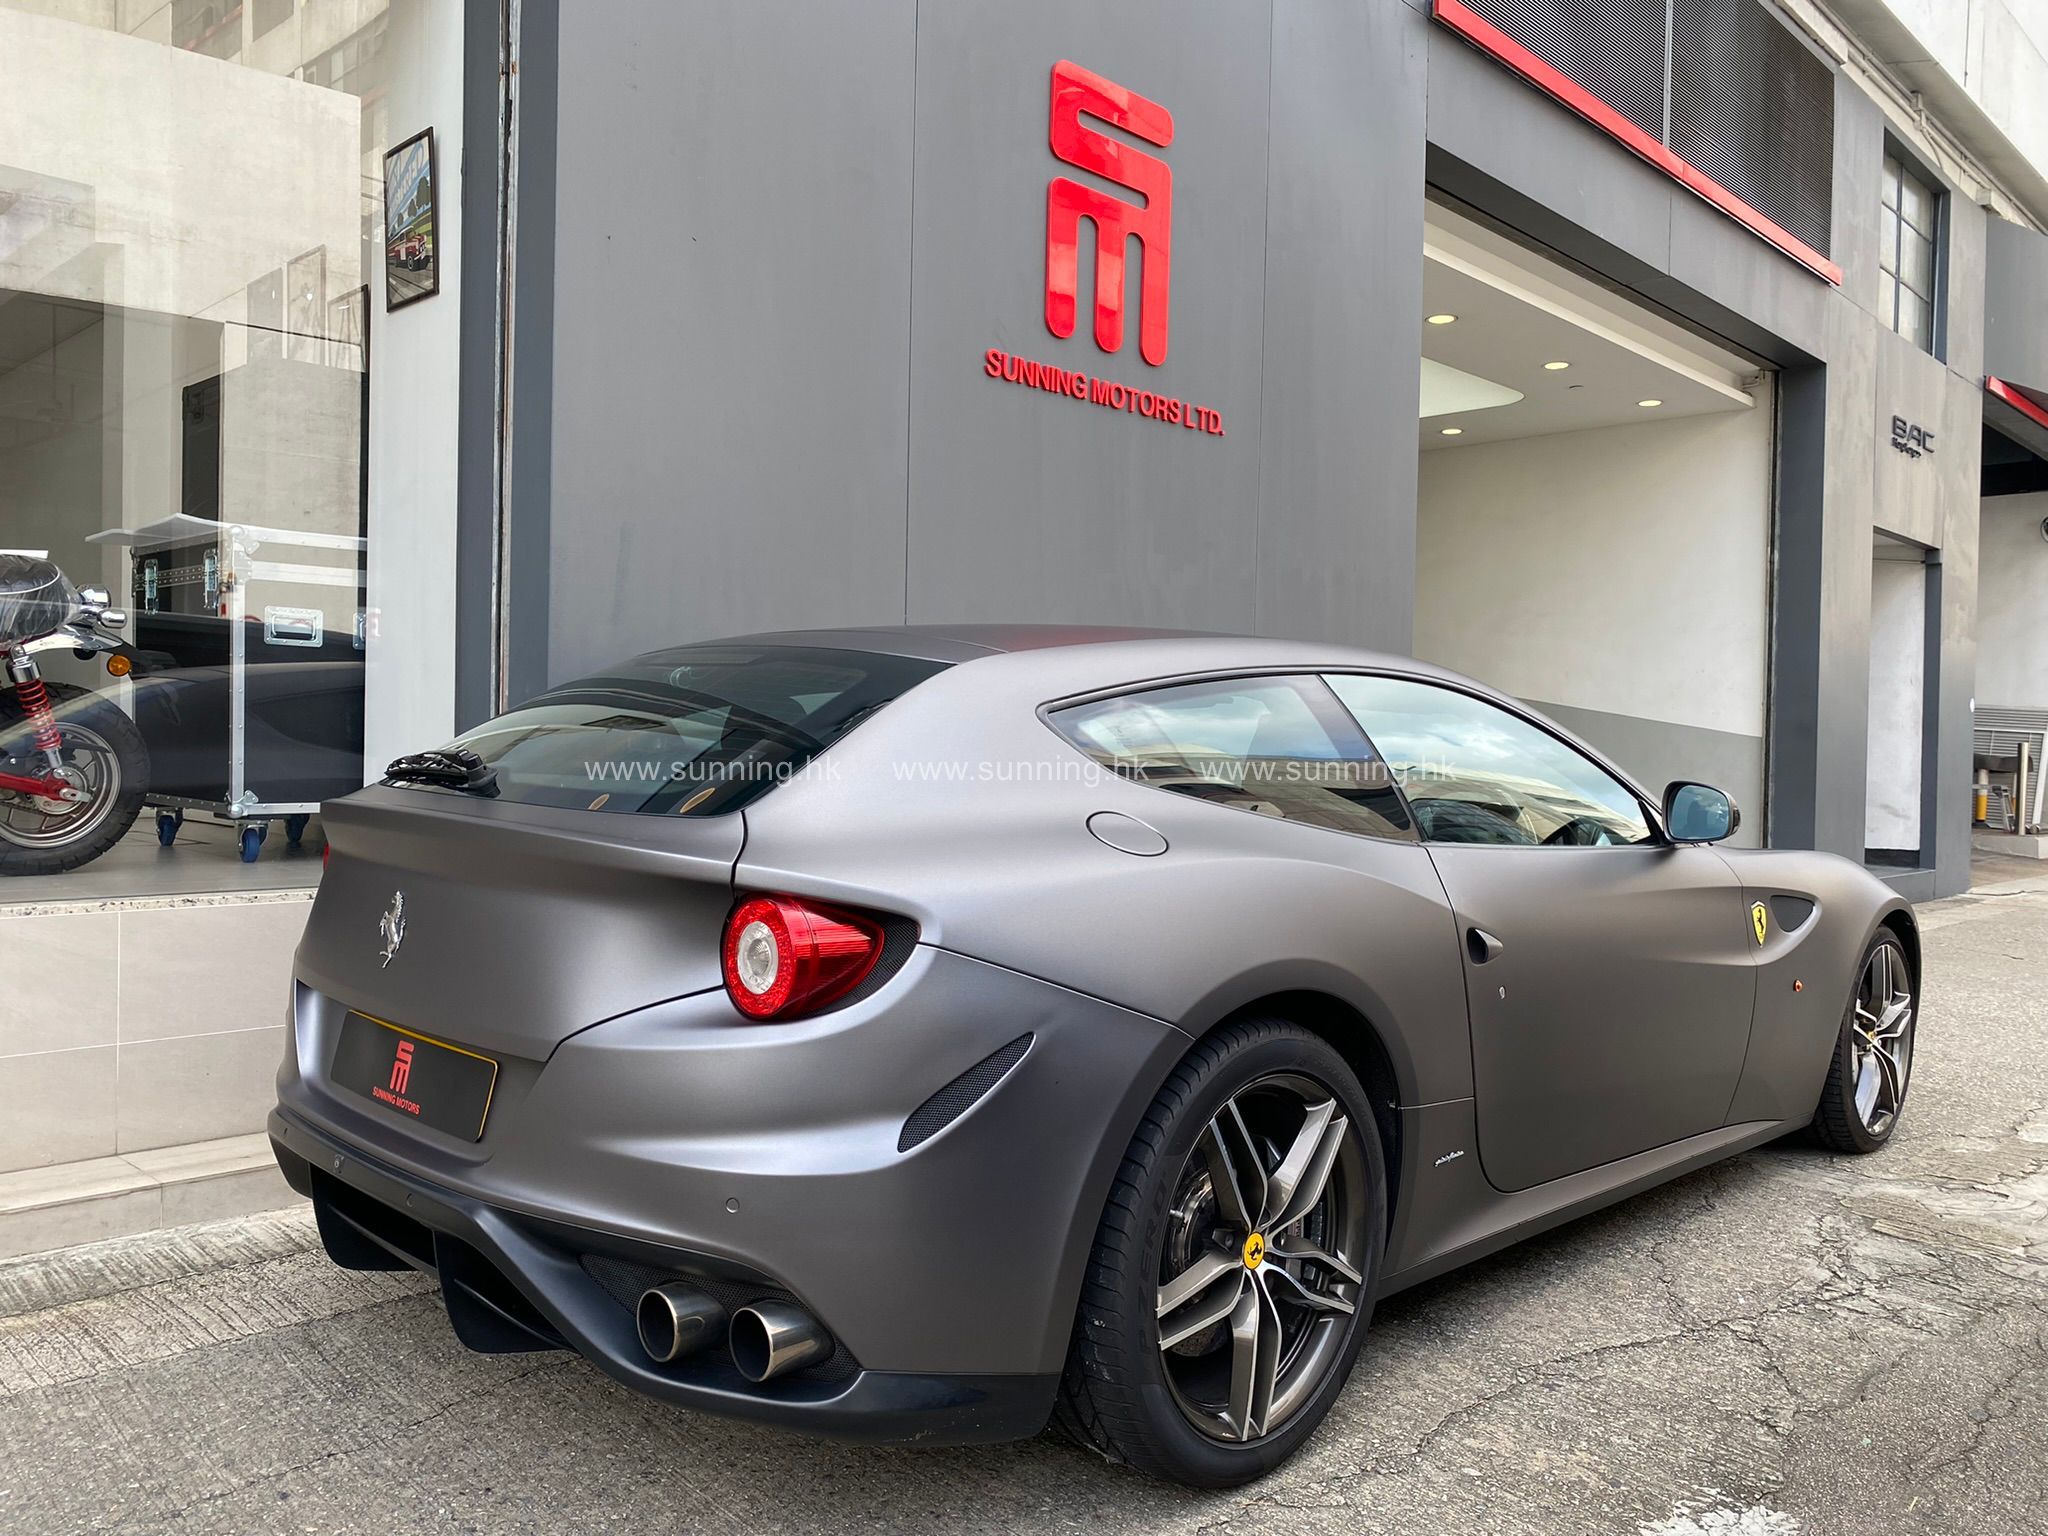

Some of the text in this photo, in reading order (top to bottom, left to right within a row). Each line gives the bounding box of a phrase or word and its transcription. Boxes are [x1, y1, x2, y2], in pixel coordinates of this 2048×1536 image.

[985, 348, 1225, 436] SUNNING MOTORS LTD.
[1892, 415, 1935, 453] BAC
[372, 1086, 419, 1115] SUNNING MOTORS
